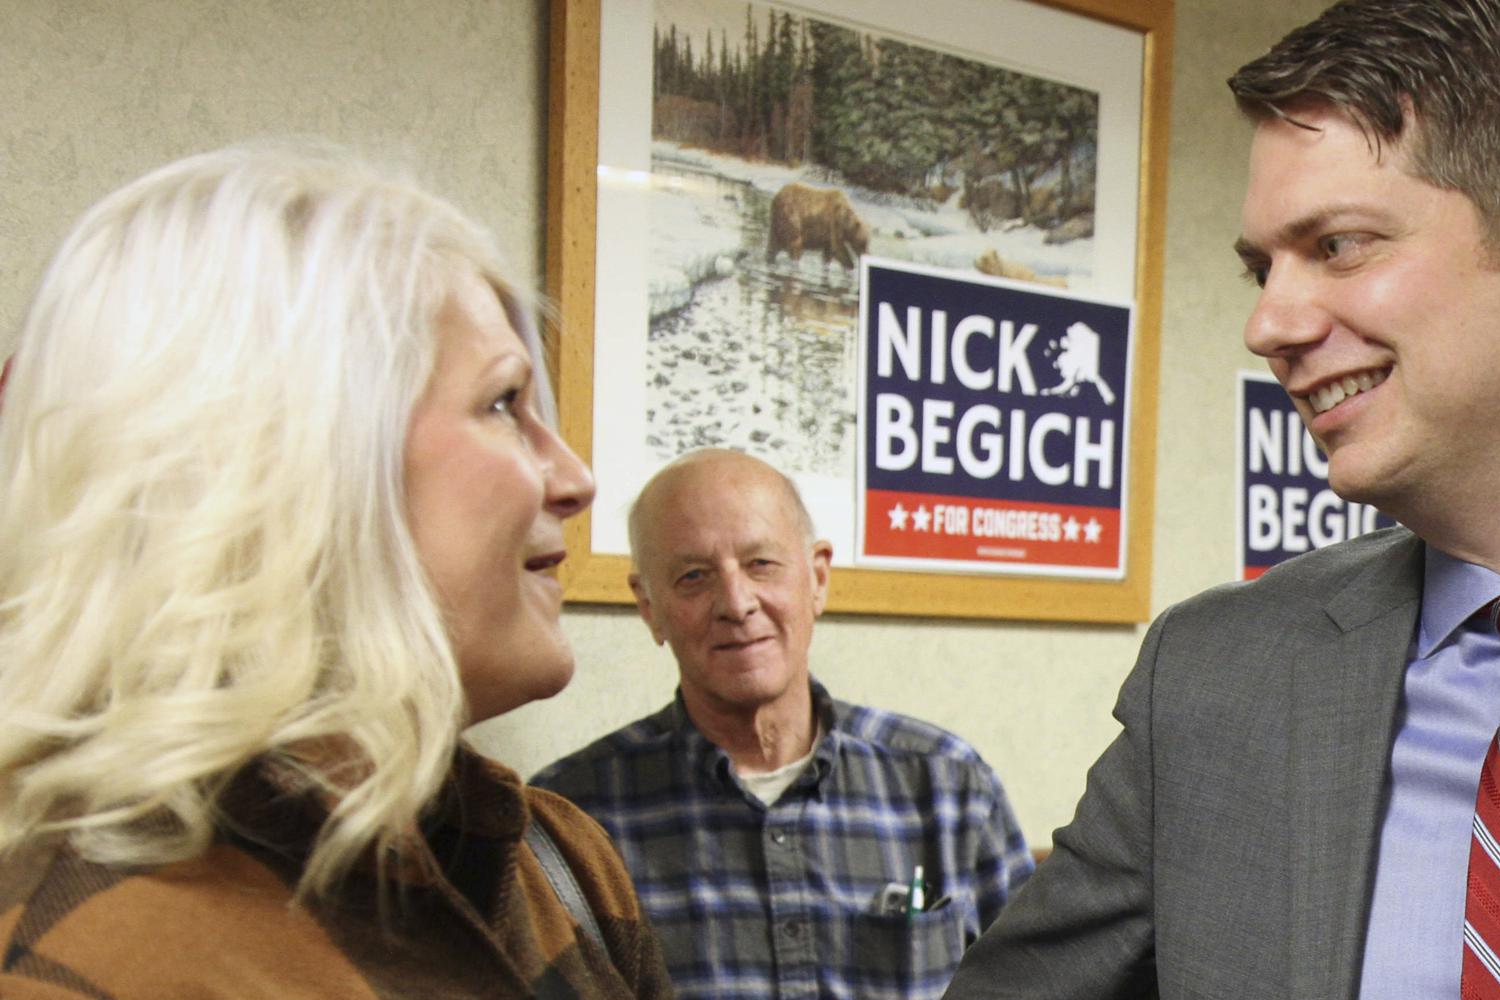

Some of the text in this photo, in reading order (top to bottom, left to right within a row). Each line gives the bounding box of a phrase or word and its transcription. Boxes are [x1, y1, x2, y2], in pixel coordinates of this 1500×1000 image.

[876, 302, 1038, 396] NICK
[876, 393, 1115, 490] BEGICH
[1249, 407, 1329, 480] NIC
[933, 505, 1062, 542] FOR CONGRESS
